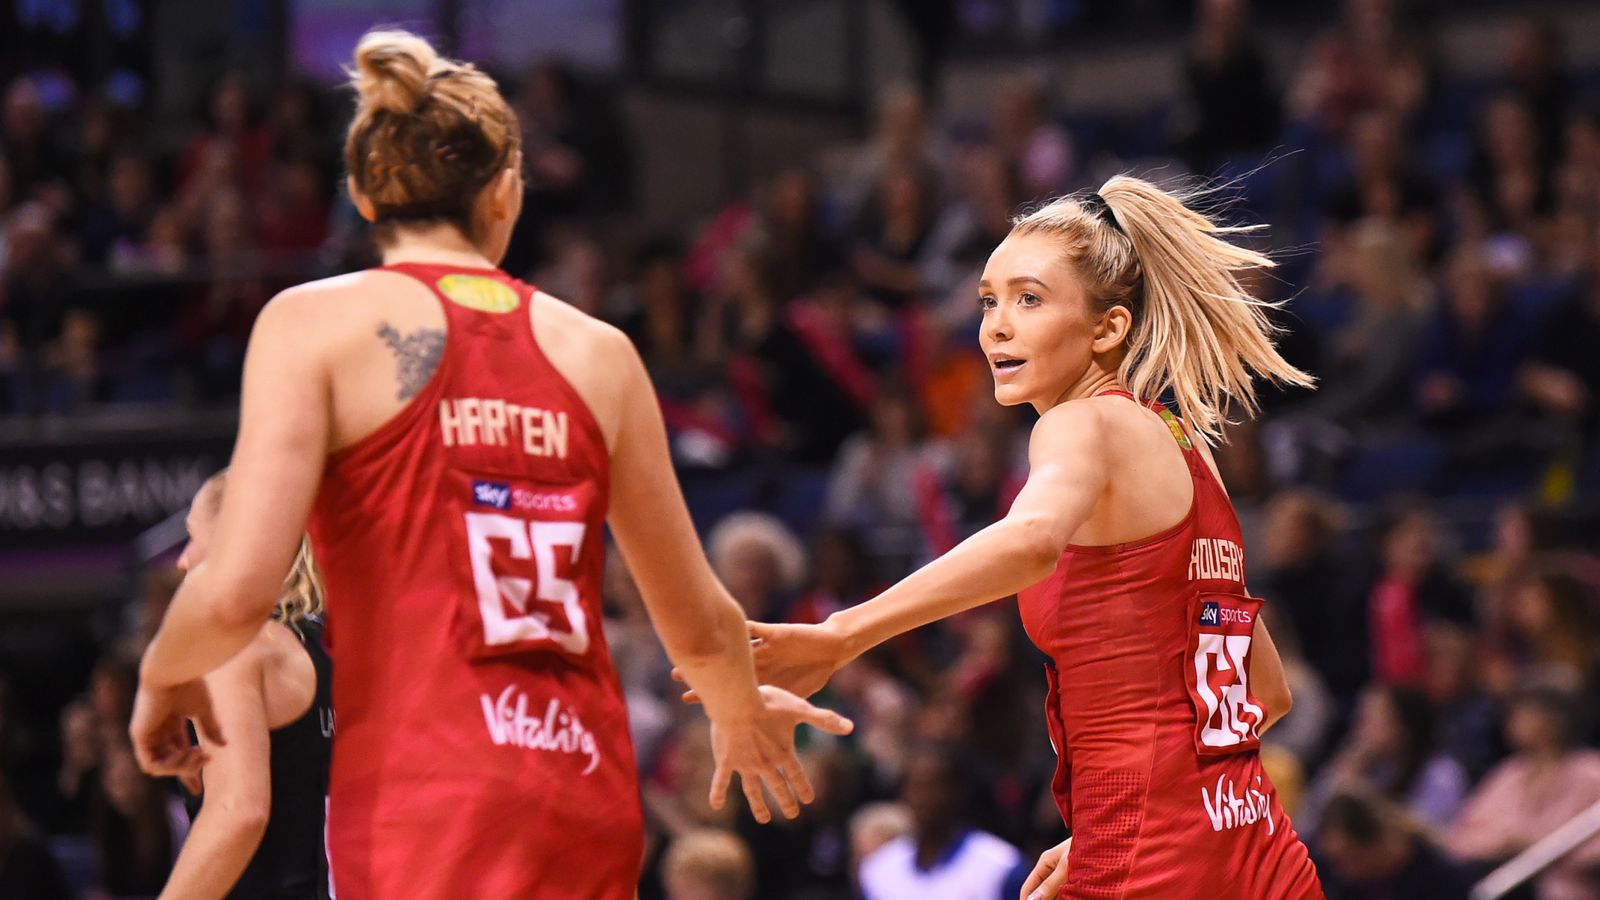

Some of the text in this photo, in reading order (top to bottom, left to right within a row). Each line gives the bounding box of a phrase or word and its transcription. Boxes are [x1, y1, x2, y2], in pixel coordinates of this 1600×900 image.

[440, 397, 568, 459] HARTEN
[474, 482, 577, 511] sky sports
[464, 511, 589, 656] GS
[1188, 537, 1246, 587] HOUSBY
[1201, 603, 1252, 625] sky sports
[479, 683, 601, 775] Vitality
[1201, 773, 1275, 836] Vitality
